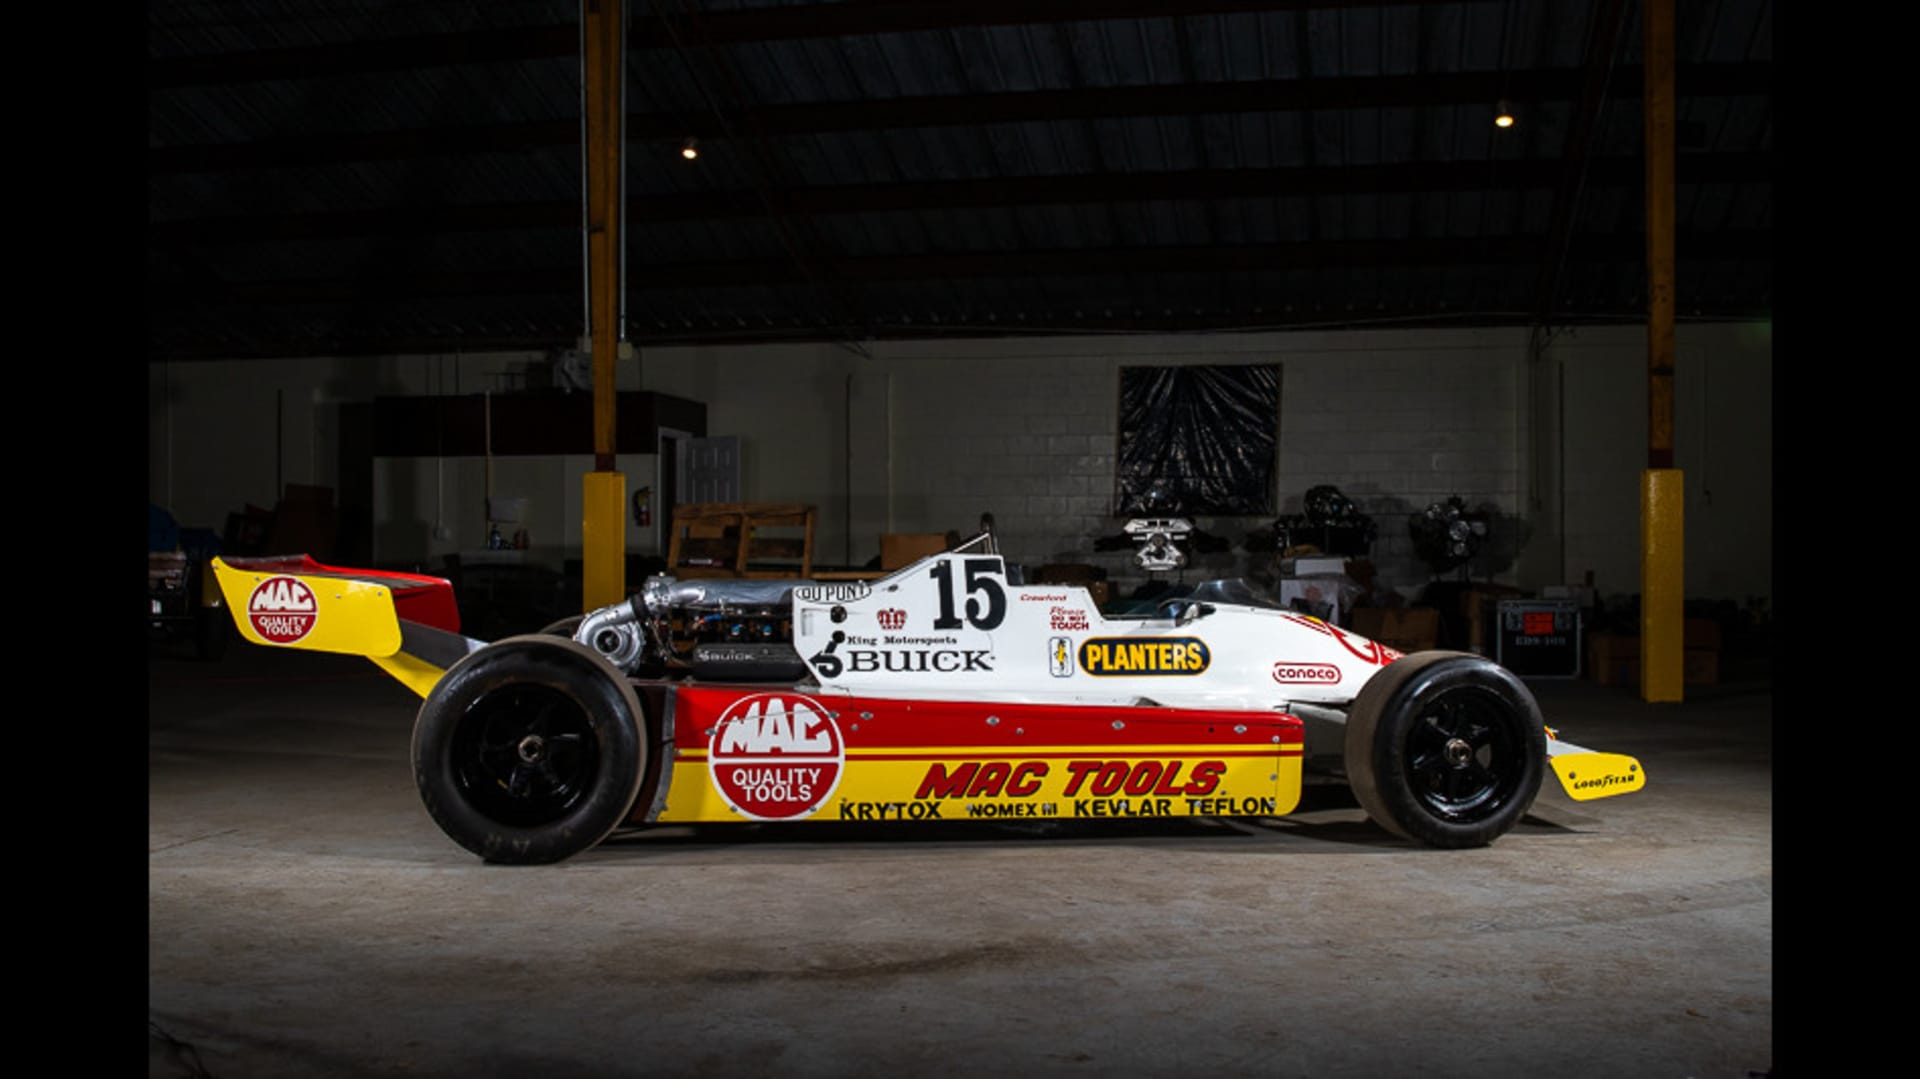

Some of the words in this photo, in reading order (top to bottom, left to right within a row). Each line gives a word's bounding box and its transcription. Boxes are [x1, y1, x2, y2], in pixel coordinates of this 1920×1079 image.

[252, 580, 314, 611] MAC
[929, 559, 1007, 631] 15
[259, 616, 307, 628] QUALITY
[265, 624, 302, 636] TOOLS
[1050, 621, 1089, 630] TOUCH
[847, 636, 877, 647] King
[884, 636, 957, 646] Motorsports
[847, 650, 993, 672] BUICK
[1086, 643, 1203, 671] PLANTERS
[1278, 668, 1335, 679] conoco
[719, 697, 832, 753] MAC
[732, 768, 822, 786] QUALITY
[914, 762, 1050, 799] MAC
[1062, 760, 1228, 798] TOOLS
[743, 784, 812, 801] TOOLS
[839, 800, 943, 820] KRYTOX
[970, 803, 1037, 817] NOMEX
[1074, 799, 1172, 817] KEVLAR
[1185, 797, 1276, 815] TEFLON
